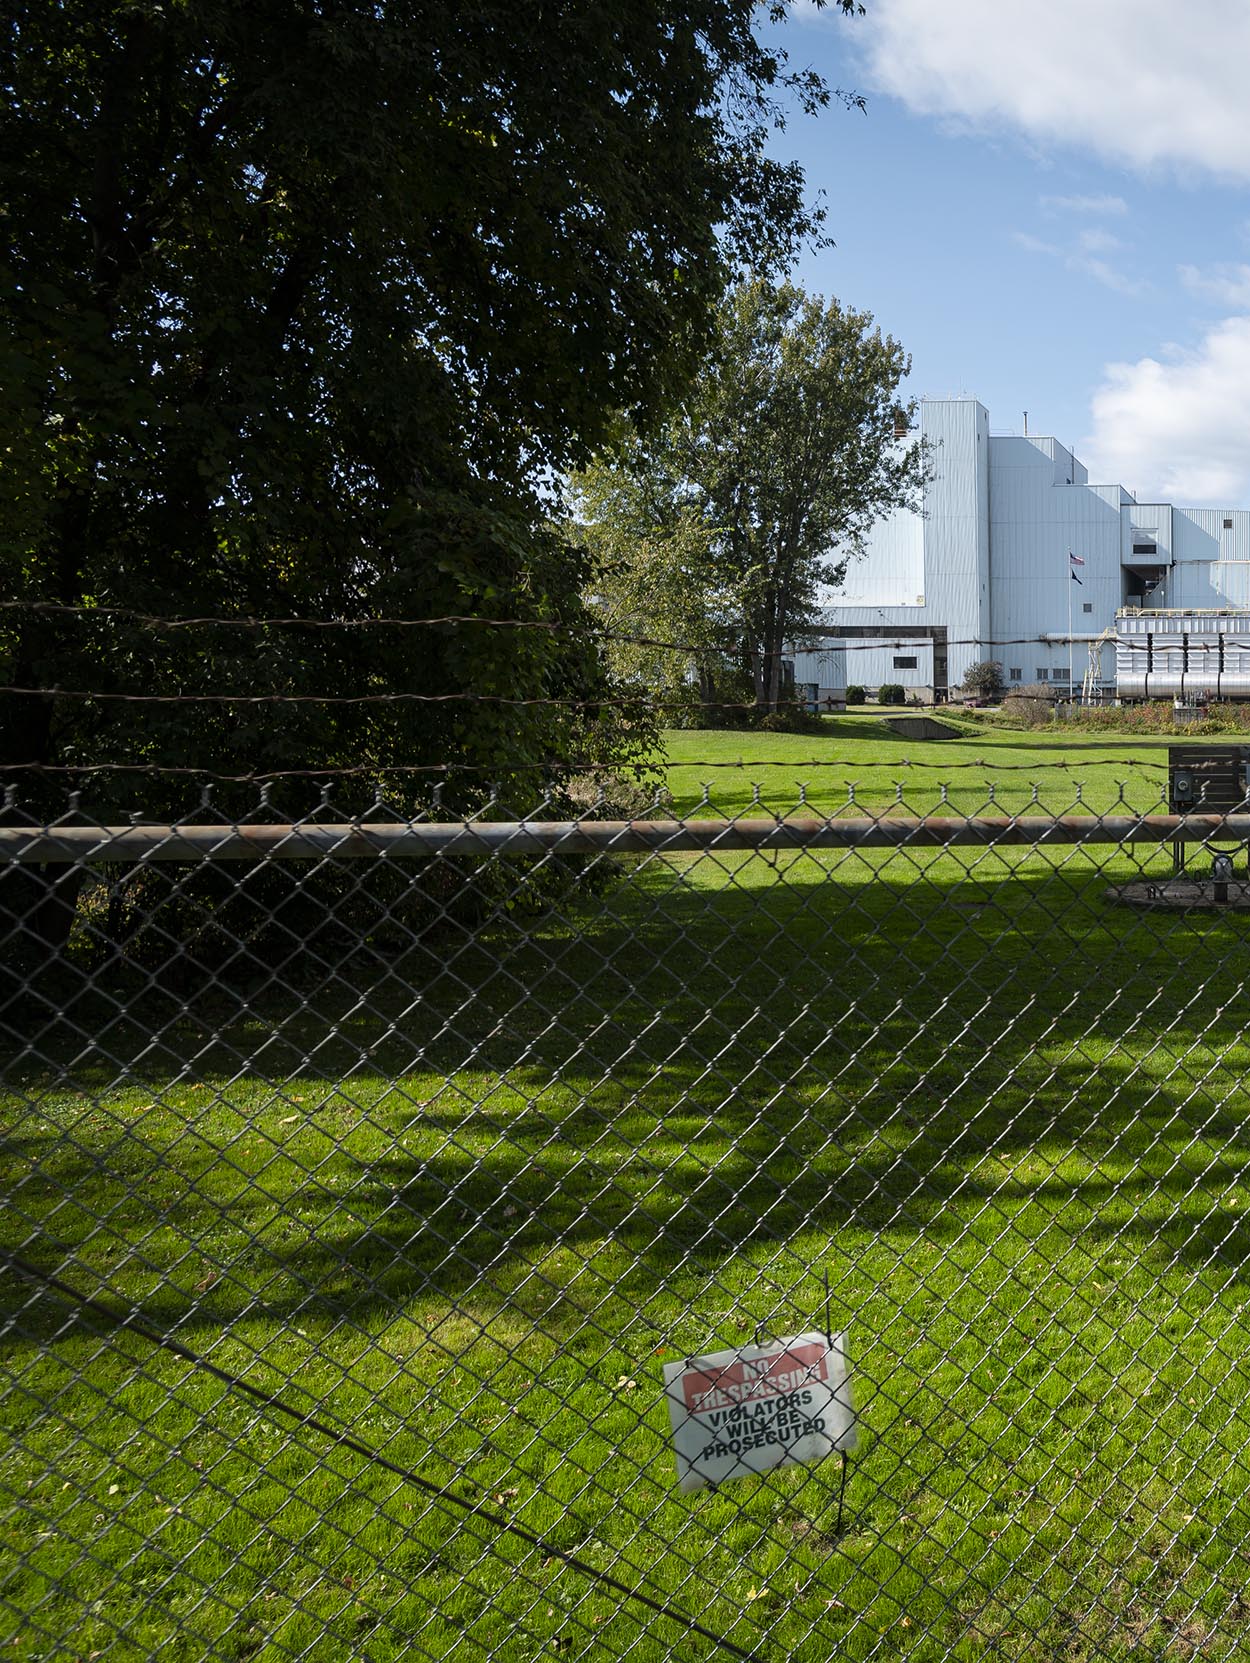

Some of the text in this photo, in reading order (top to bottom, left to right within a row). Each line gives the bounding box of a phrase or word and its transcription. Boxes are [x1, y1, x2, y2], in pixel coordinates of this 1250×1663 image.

[691, 1363, 821, 1410] TRESPASSING
[742, 1359, 769, 1380] NO
[708, 1390, 812, 1427] VIOLATORS
[726, 1409, 801, 1438] WILL BE
[703, 1418, 825, 1461] PROSECUTED
